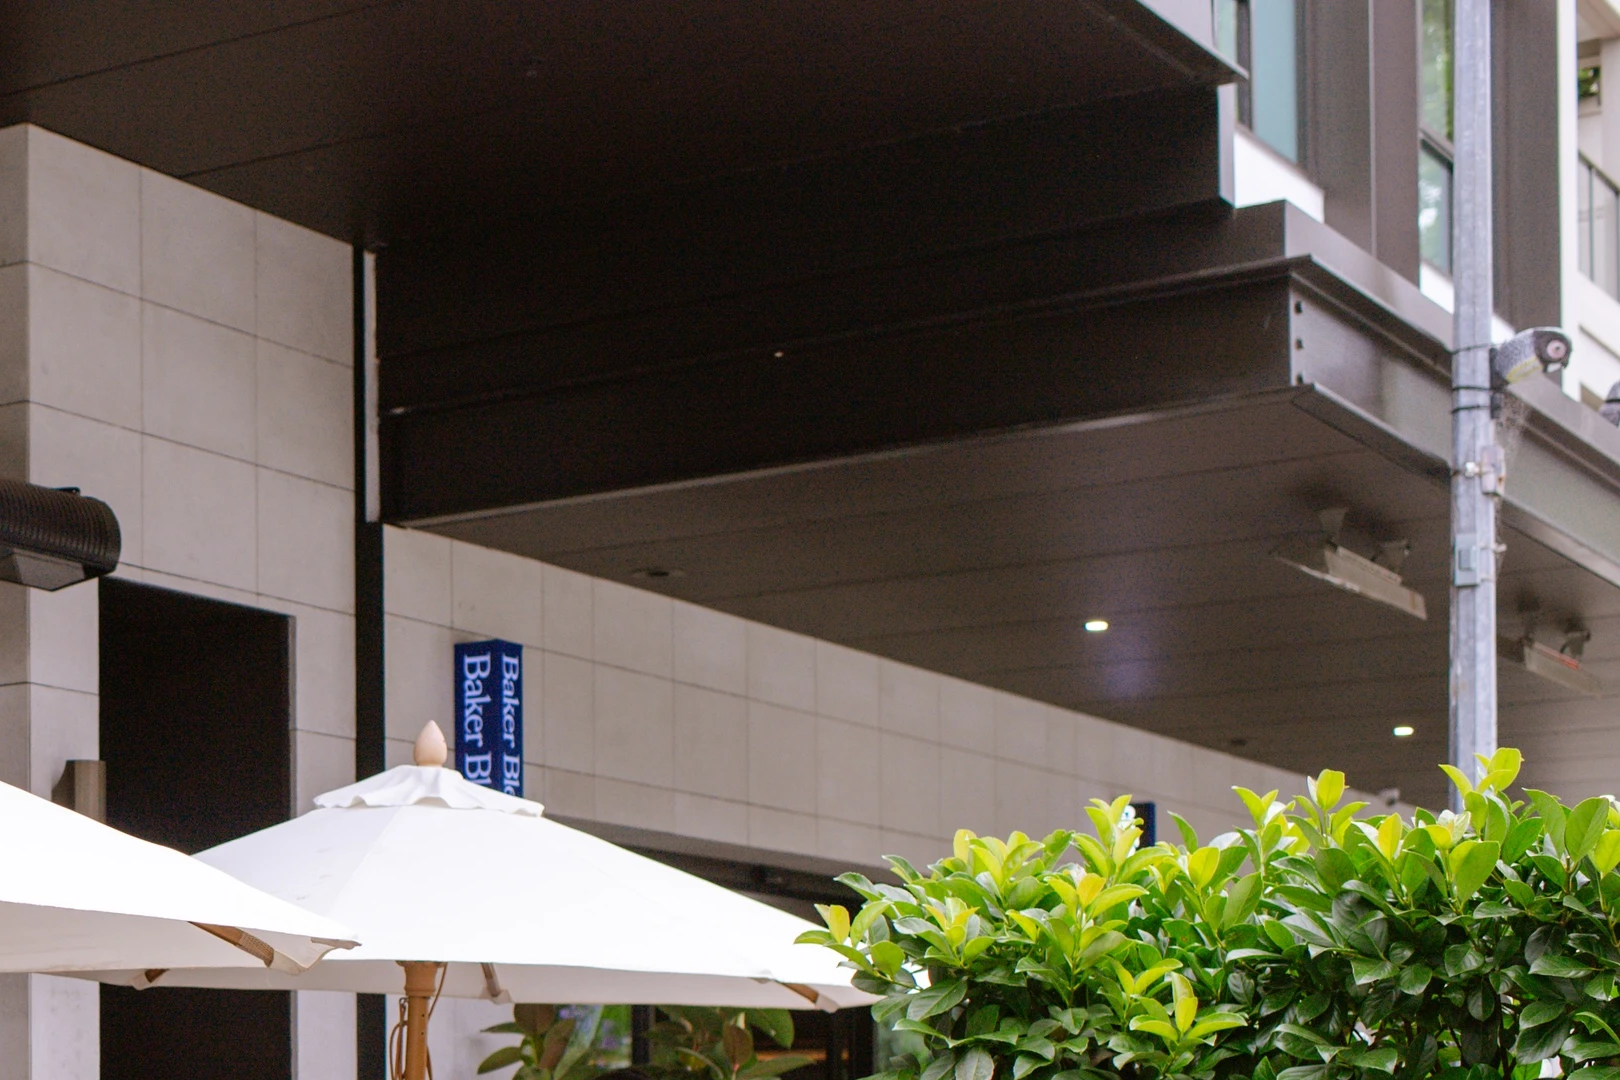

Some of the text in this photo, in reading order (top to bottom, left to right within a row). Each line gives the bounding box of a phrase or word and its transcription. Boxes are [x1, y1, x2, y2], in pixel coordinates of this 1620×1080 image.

[463, 652, 493, 787] Baker Bl
[502, 653, 521, 796] Baker Ble
